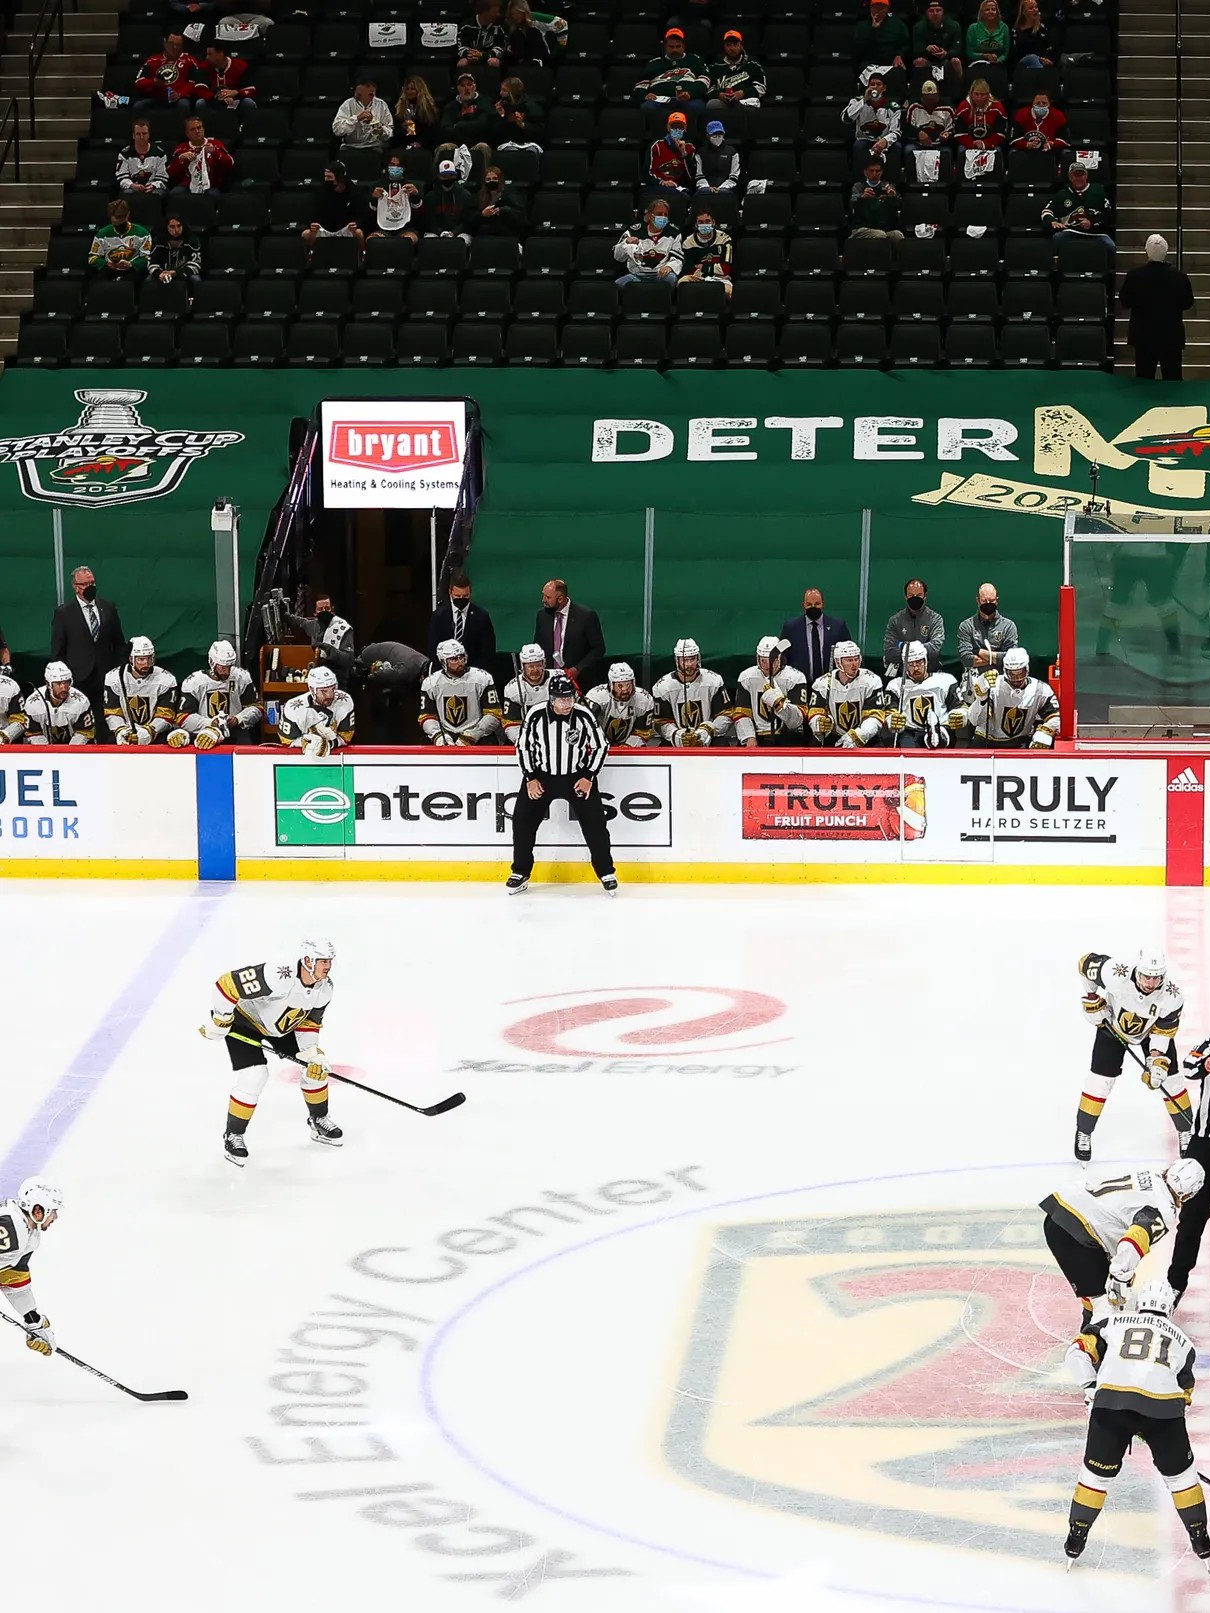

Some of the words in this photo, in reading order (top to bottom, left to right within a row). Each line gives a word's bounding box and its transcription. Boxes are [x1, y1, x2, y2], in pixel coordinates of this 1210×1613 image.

[154, 432, 240, 447] CUP
[347, 428, 442, 461] bryant
[11, 446, 205, 461] PLAYOFFS
[72, 485, 127, 493] 2021
[330, 479, 366, 490] Heating
[370, 479, 377, 489] &
[380, 479, 416, 491] Cooling
[420, 479, 460, 491] Systems
[0, 769, 78, 807] EL
[760, 783, 882, 811] TRULY
[960, 775, 1119, 812] TRULY
[1167, 782, 1204, 792] adidas
[0, 816, 79, 839] OOK
[774, 815, 812, 827] FRUIT
[816, 815, 867, 827] PUNCH
[971, 818, 1021, 829] HARD
[1029, 818, 1106, 829] SELTZER
[238, 967, 262, 996] 22
[1149, 1003, 1157, 1016] A
[443, 1058, 594, 1074] Xcel
[600, 1060, 808, 1079] Energy
[347, 1164, 707, 1285] Center
[1113, 1316, 1188, 1348] MARCHESSAULT
[1119, 1327, 1173, 1370] 81
[242, 1293, 434, 1466] Energy
[294, 1481, 636, 1601] Xcel
